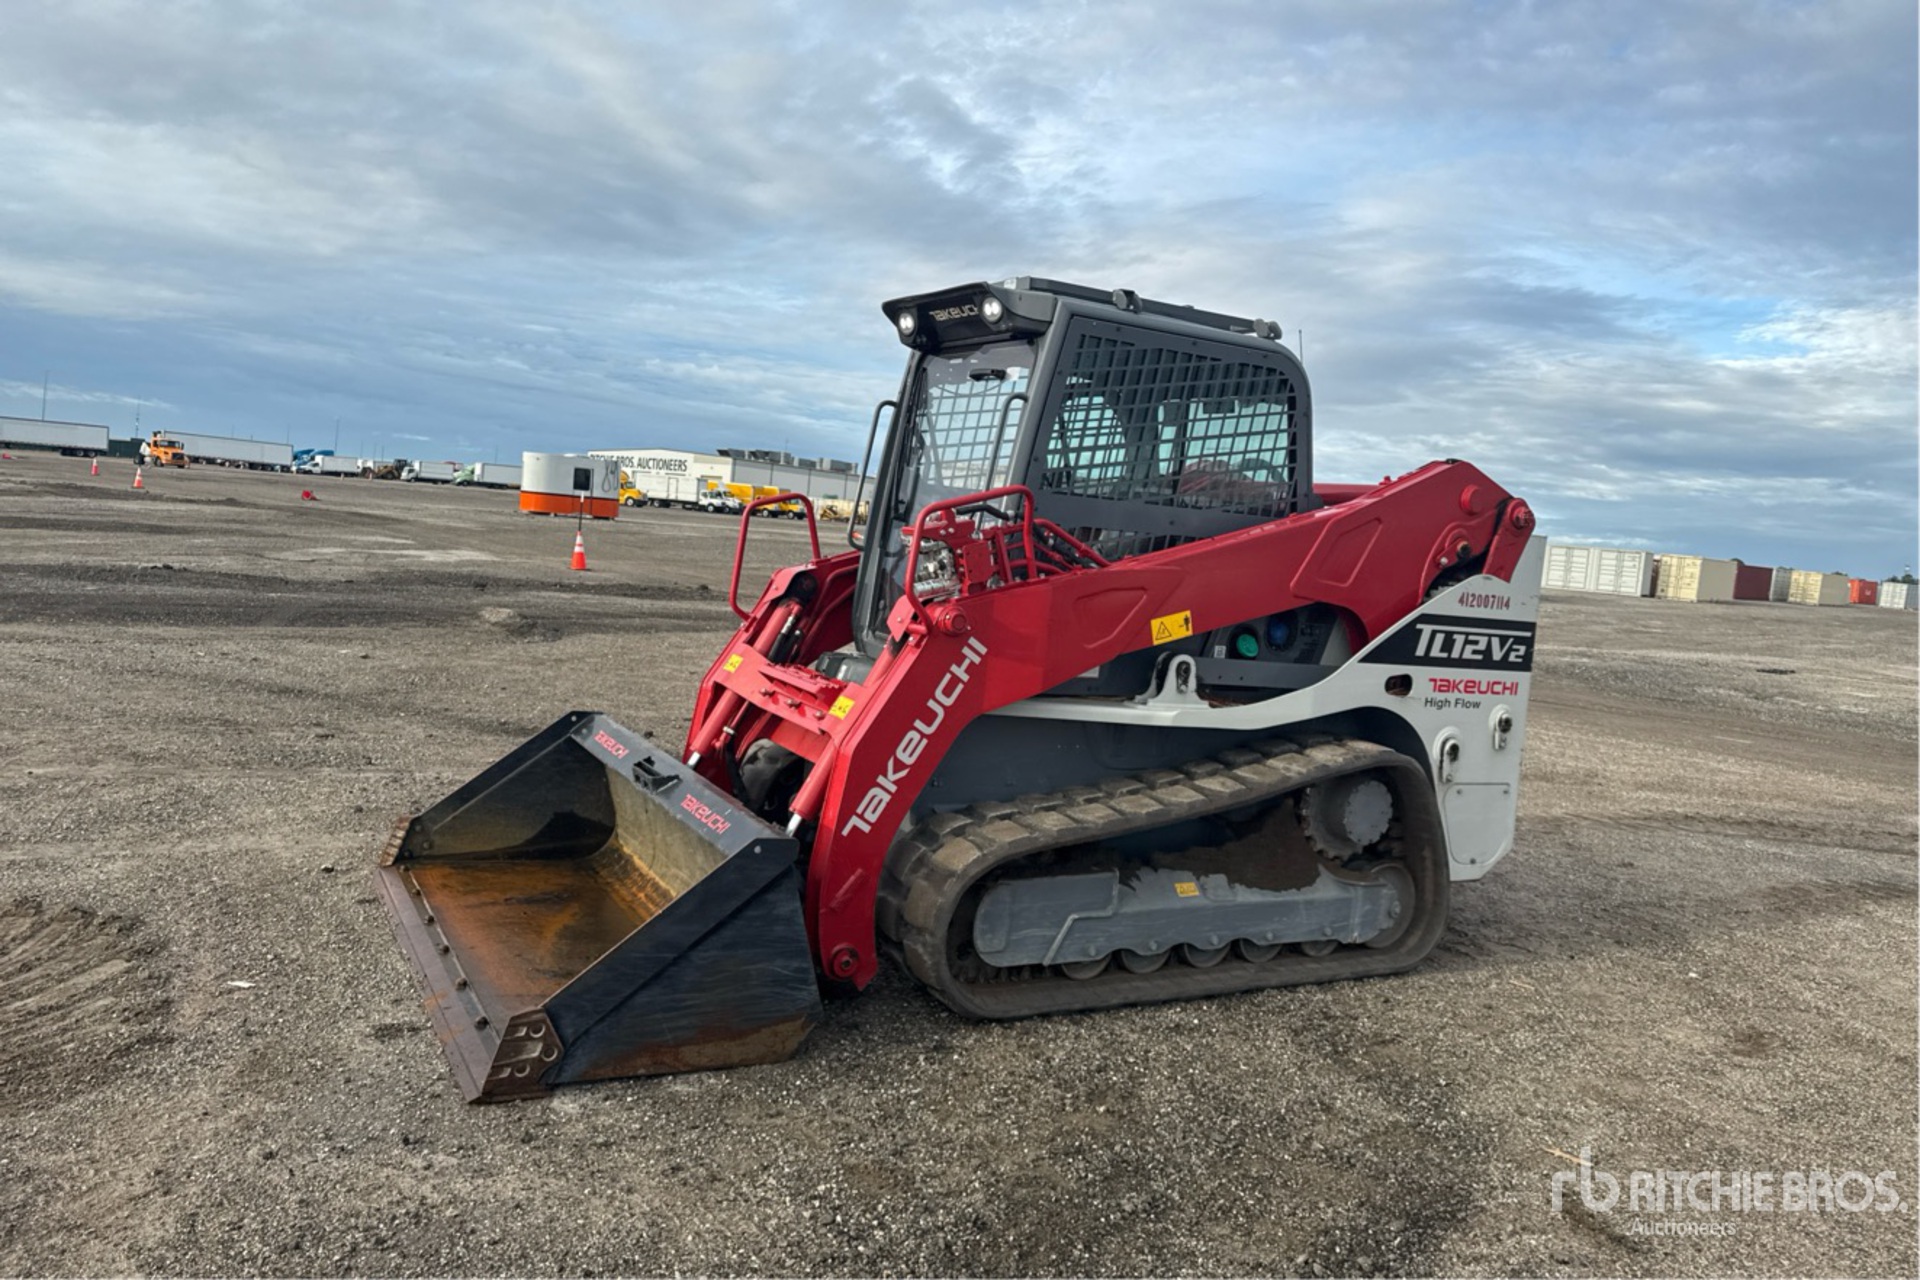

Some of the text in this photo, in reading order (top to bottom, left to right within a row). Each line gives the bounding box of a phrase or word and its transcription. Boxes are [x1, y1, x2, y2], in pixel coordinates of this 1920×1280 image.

[929, 304, 979, 321] TAKEUC
[637, 457, 688, 472] AUCTIONEERS
[1415, 623, 1533, 662] TL12V2
[1429, 678, 1518, 695] TAKEUCHI
[1424, 697, 1481, 710] High Flow
[841, 636, 988, 837] TAKEUCHI
[680, 794, 731, 834] TAKEUCHI
